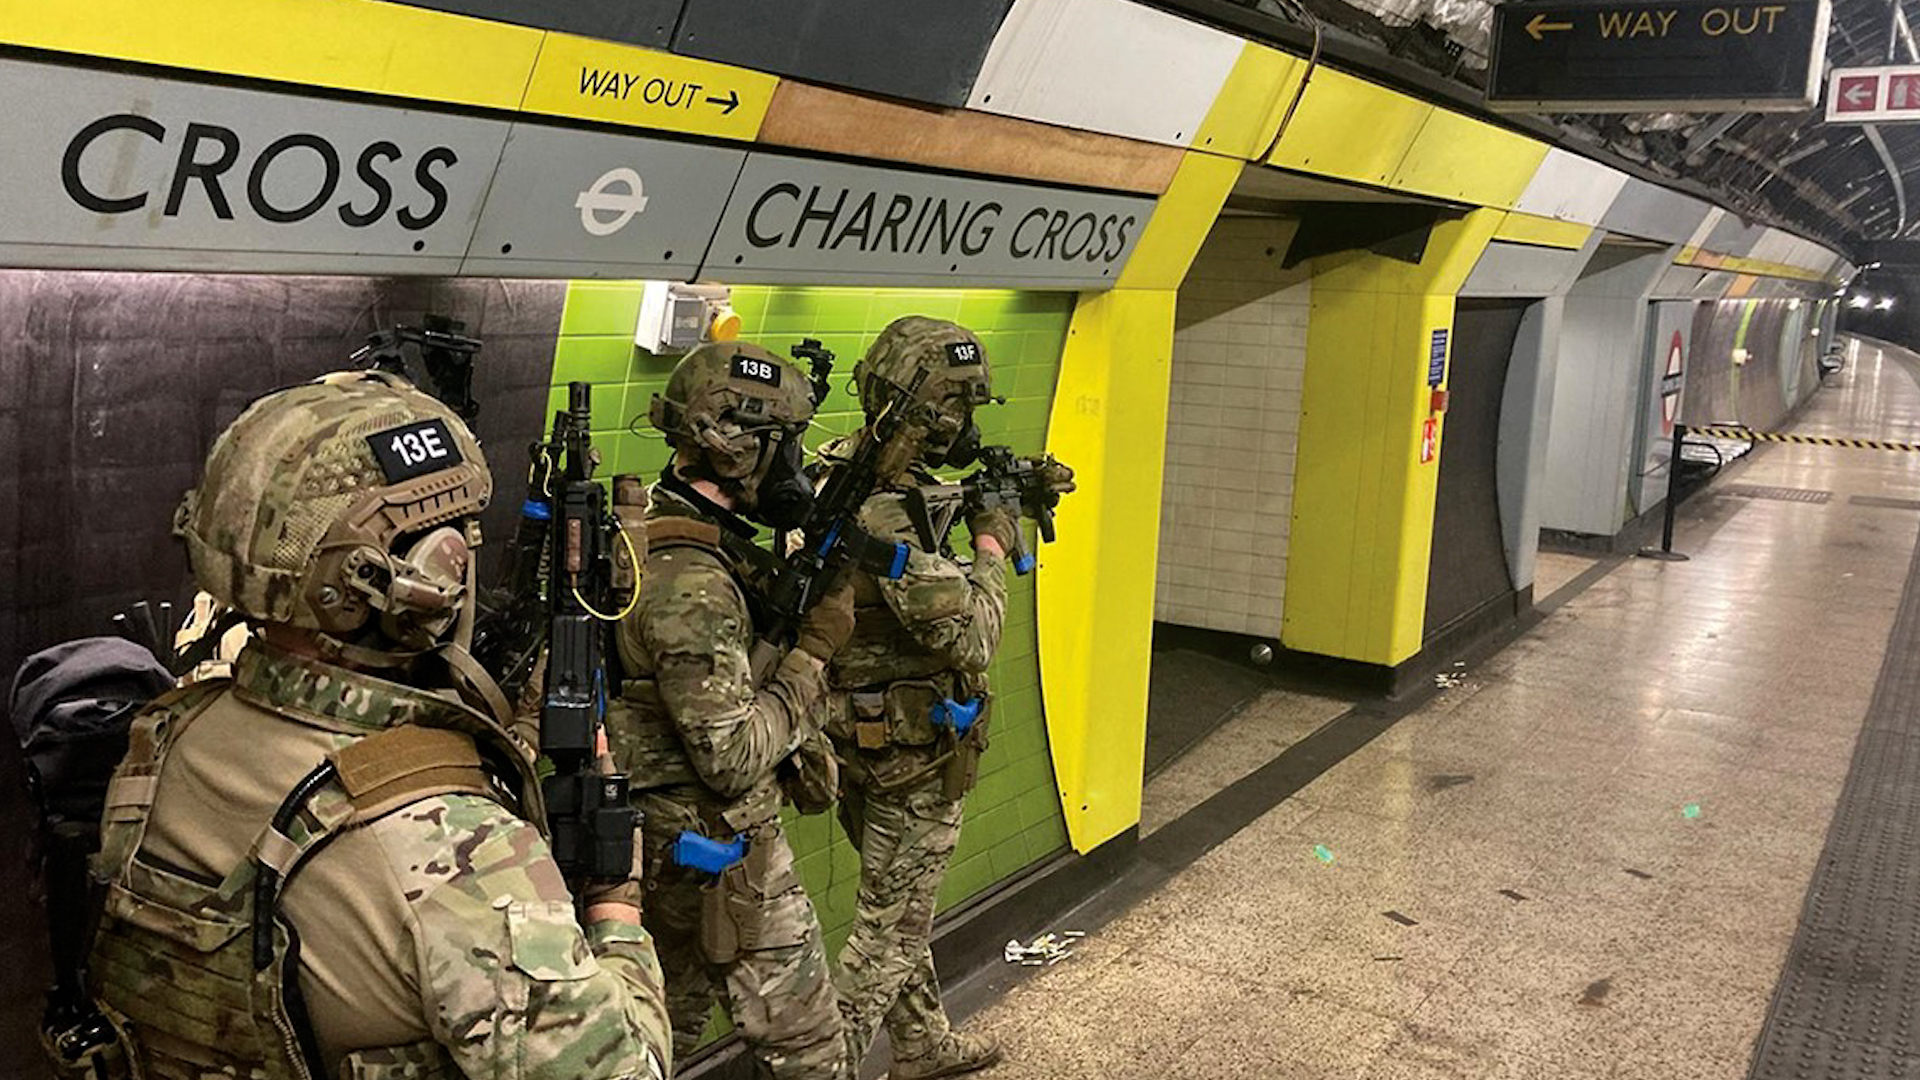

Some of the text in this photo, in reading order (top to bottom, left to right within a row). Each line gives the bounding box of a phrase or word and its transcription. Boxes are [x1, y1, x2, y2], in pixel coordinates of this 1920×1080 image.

[1599, 7, 1786, 39] WAY OUT
[579, 66, 703, 109] WAY OUT
[61, 114, 457, 230] CROSS
[745, 182, 1136, 263] CHARING CROSS
[739, 359, 773, 380] 13B
[954, 344, 975, 361] 13F
[391, 427, 448, 466] 13E
